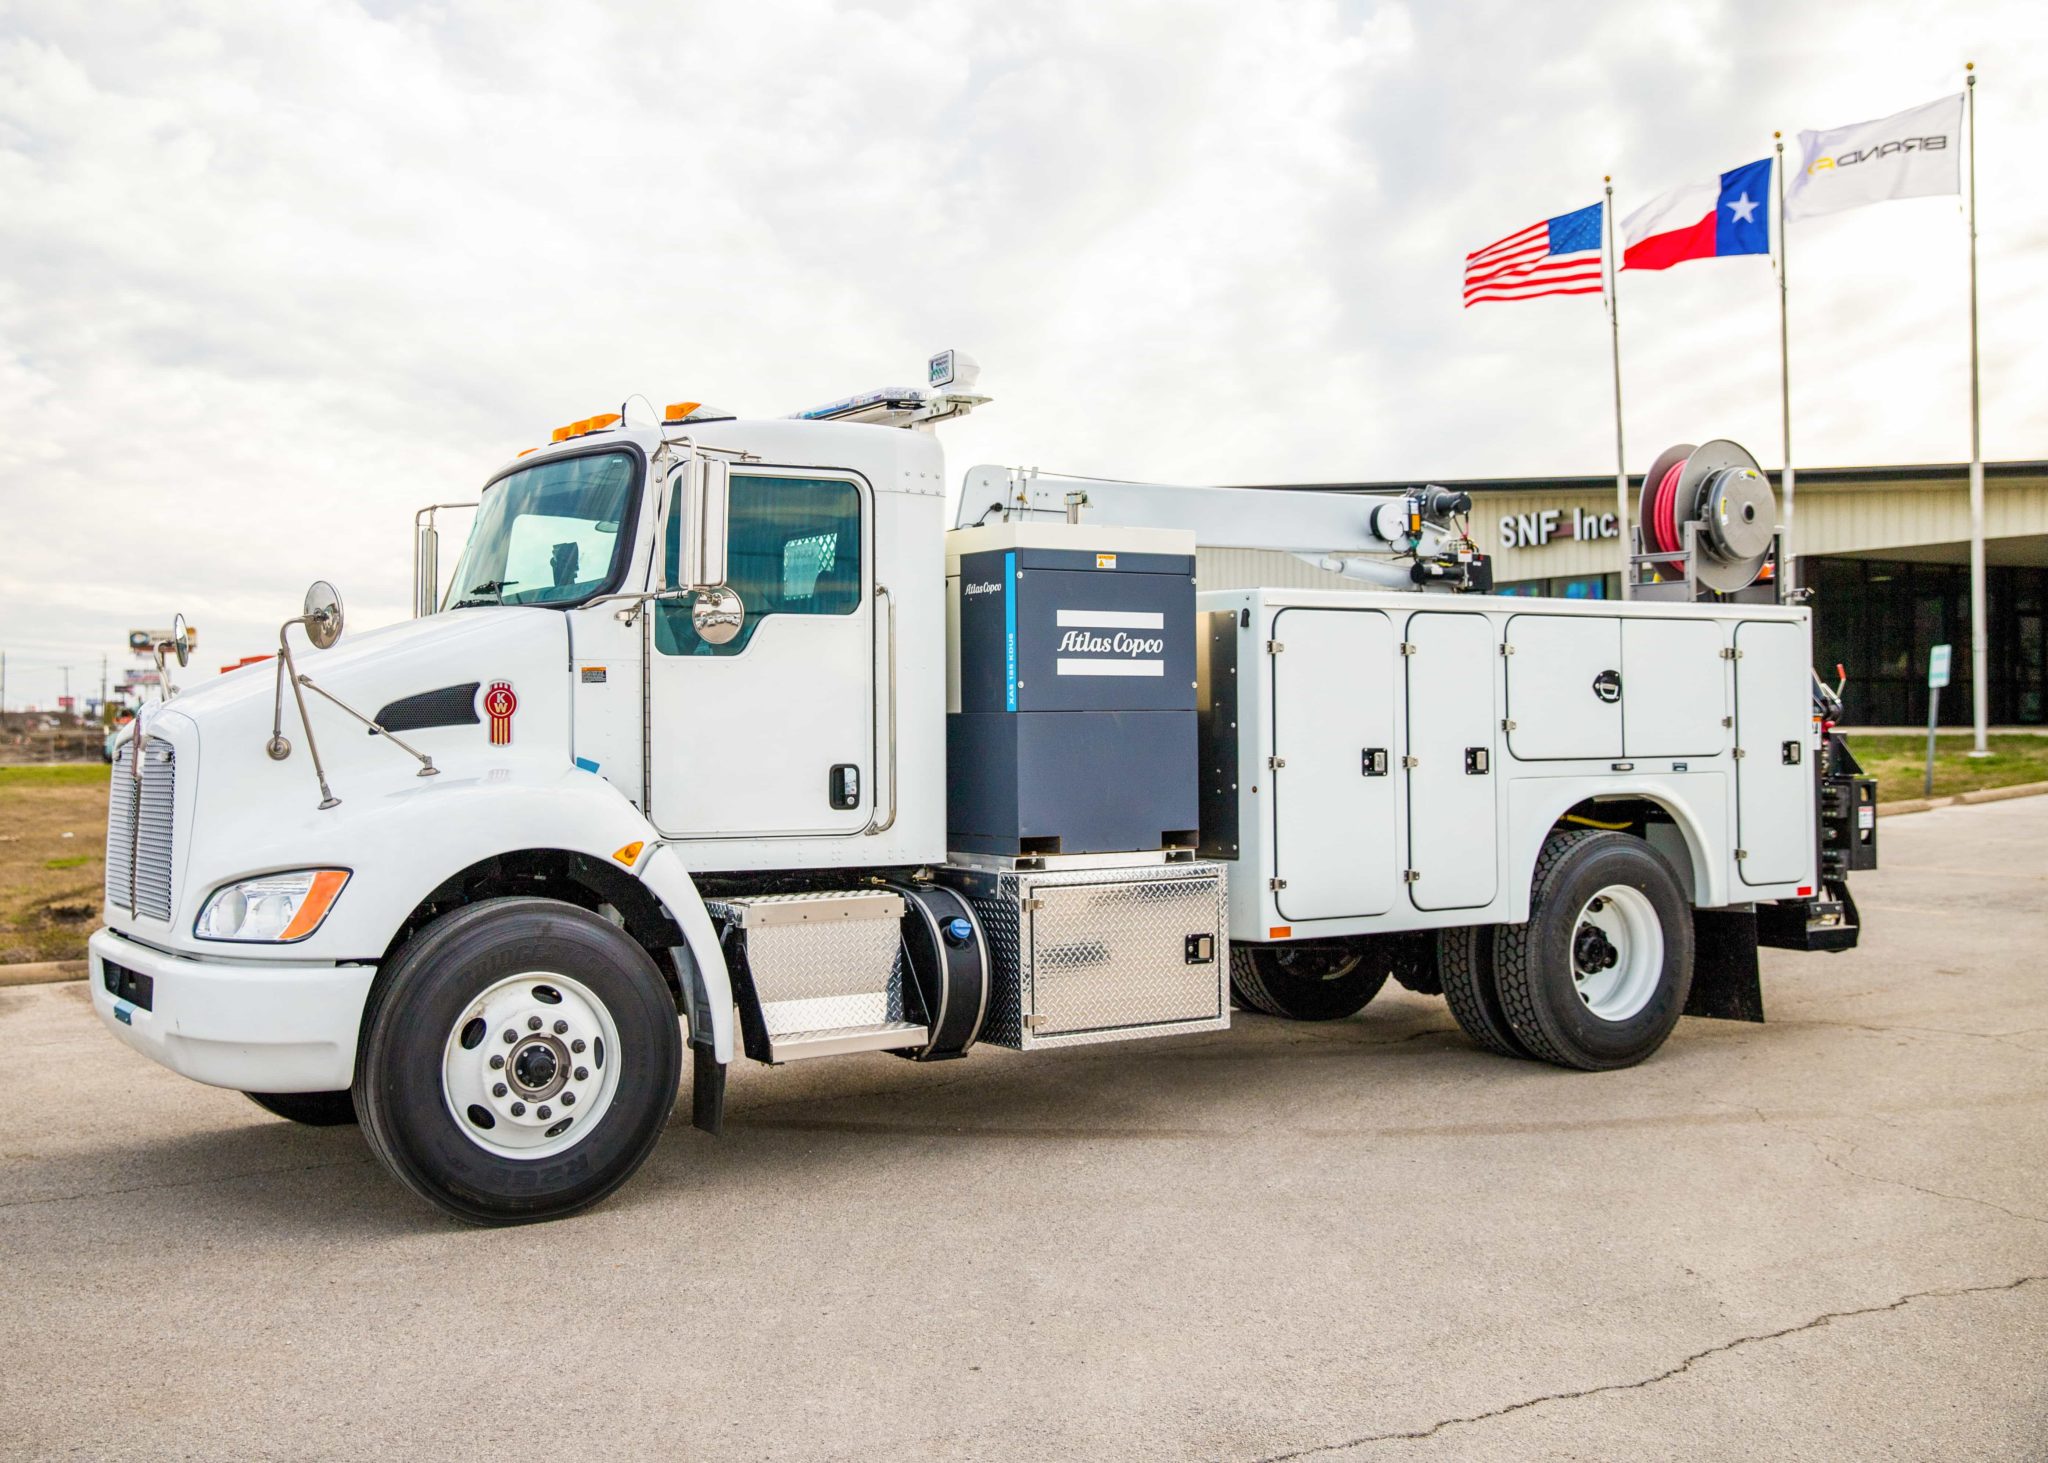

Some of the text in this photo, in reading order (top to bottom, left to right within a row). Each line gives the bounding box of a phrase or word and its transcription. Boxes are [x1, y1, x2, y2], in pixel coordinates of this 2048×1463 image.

[1499, 507, 1618, 548] SNF Inc.
[965, 581, 1001, 595] Atlas Copco
[1057, 631, 1163, 657] Atlas Copco
